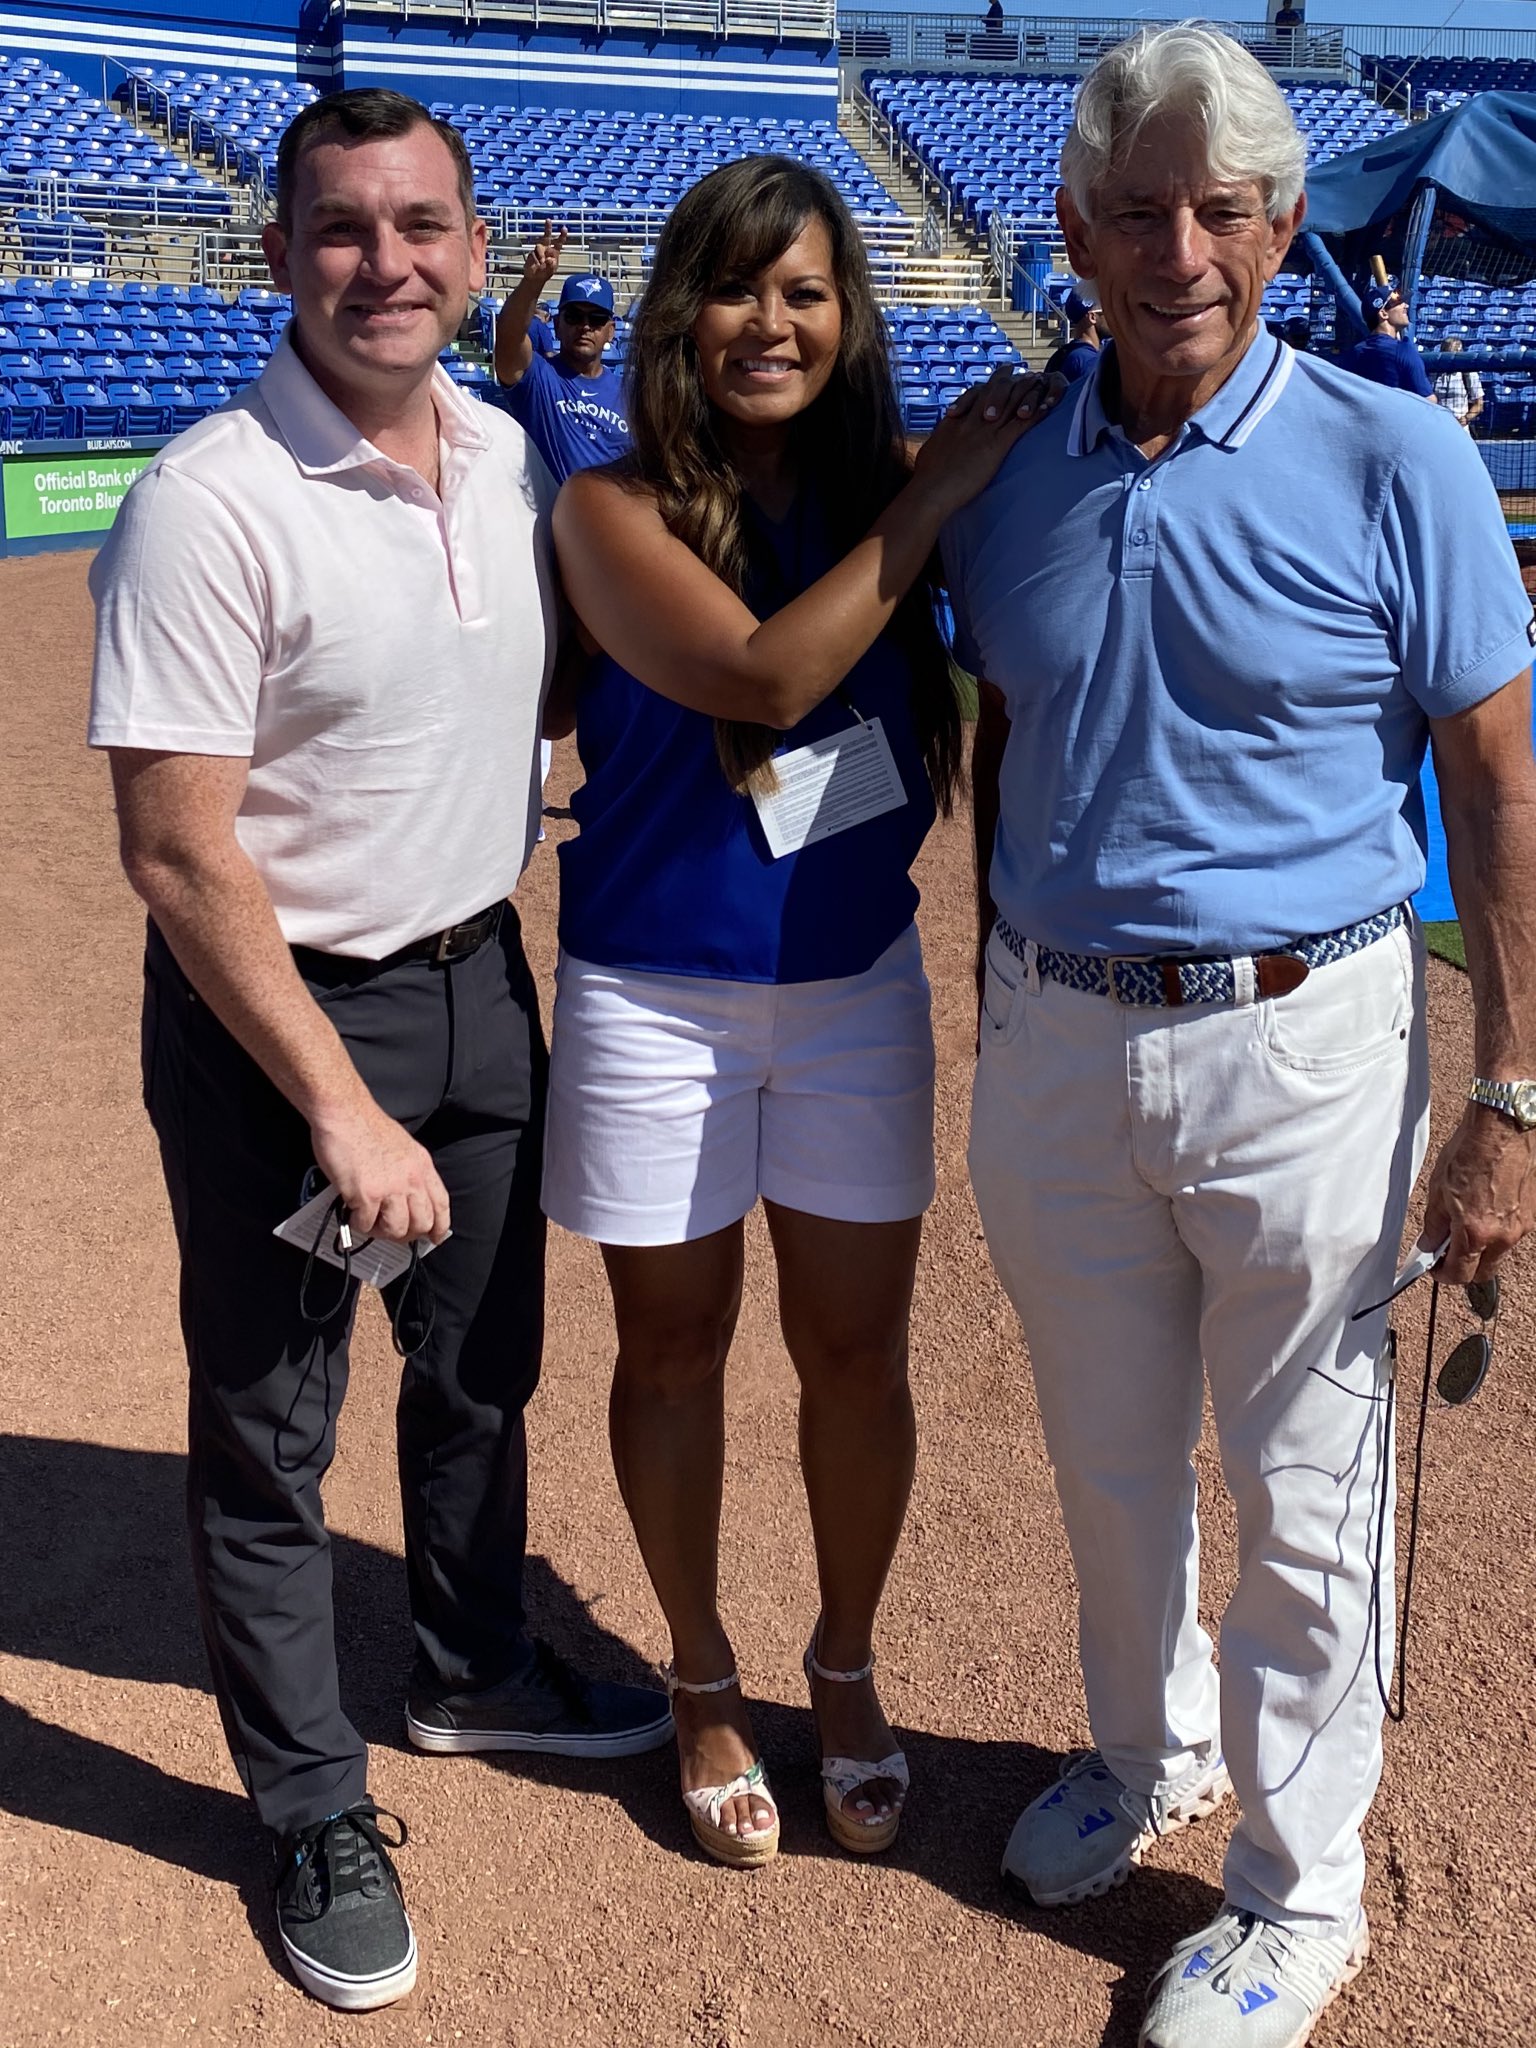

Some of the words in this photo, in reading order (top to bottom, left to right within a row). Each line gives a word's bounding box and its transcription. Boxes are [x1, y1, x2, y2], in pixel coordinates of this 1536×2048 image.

[556, 399, 629, 434] TORONTO
[87, 439, 132, 450] BLUEJAYS.COM
[34, 470, 86, 492] Official
[88, 468, 122, 488] Bank
[124, 467, 137, 486] of
[39, 495, 93, 514] Toronto
[95, 491, 124, 510] Blue
